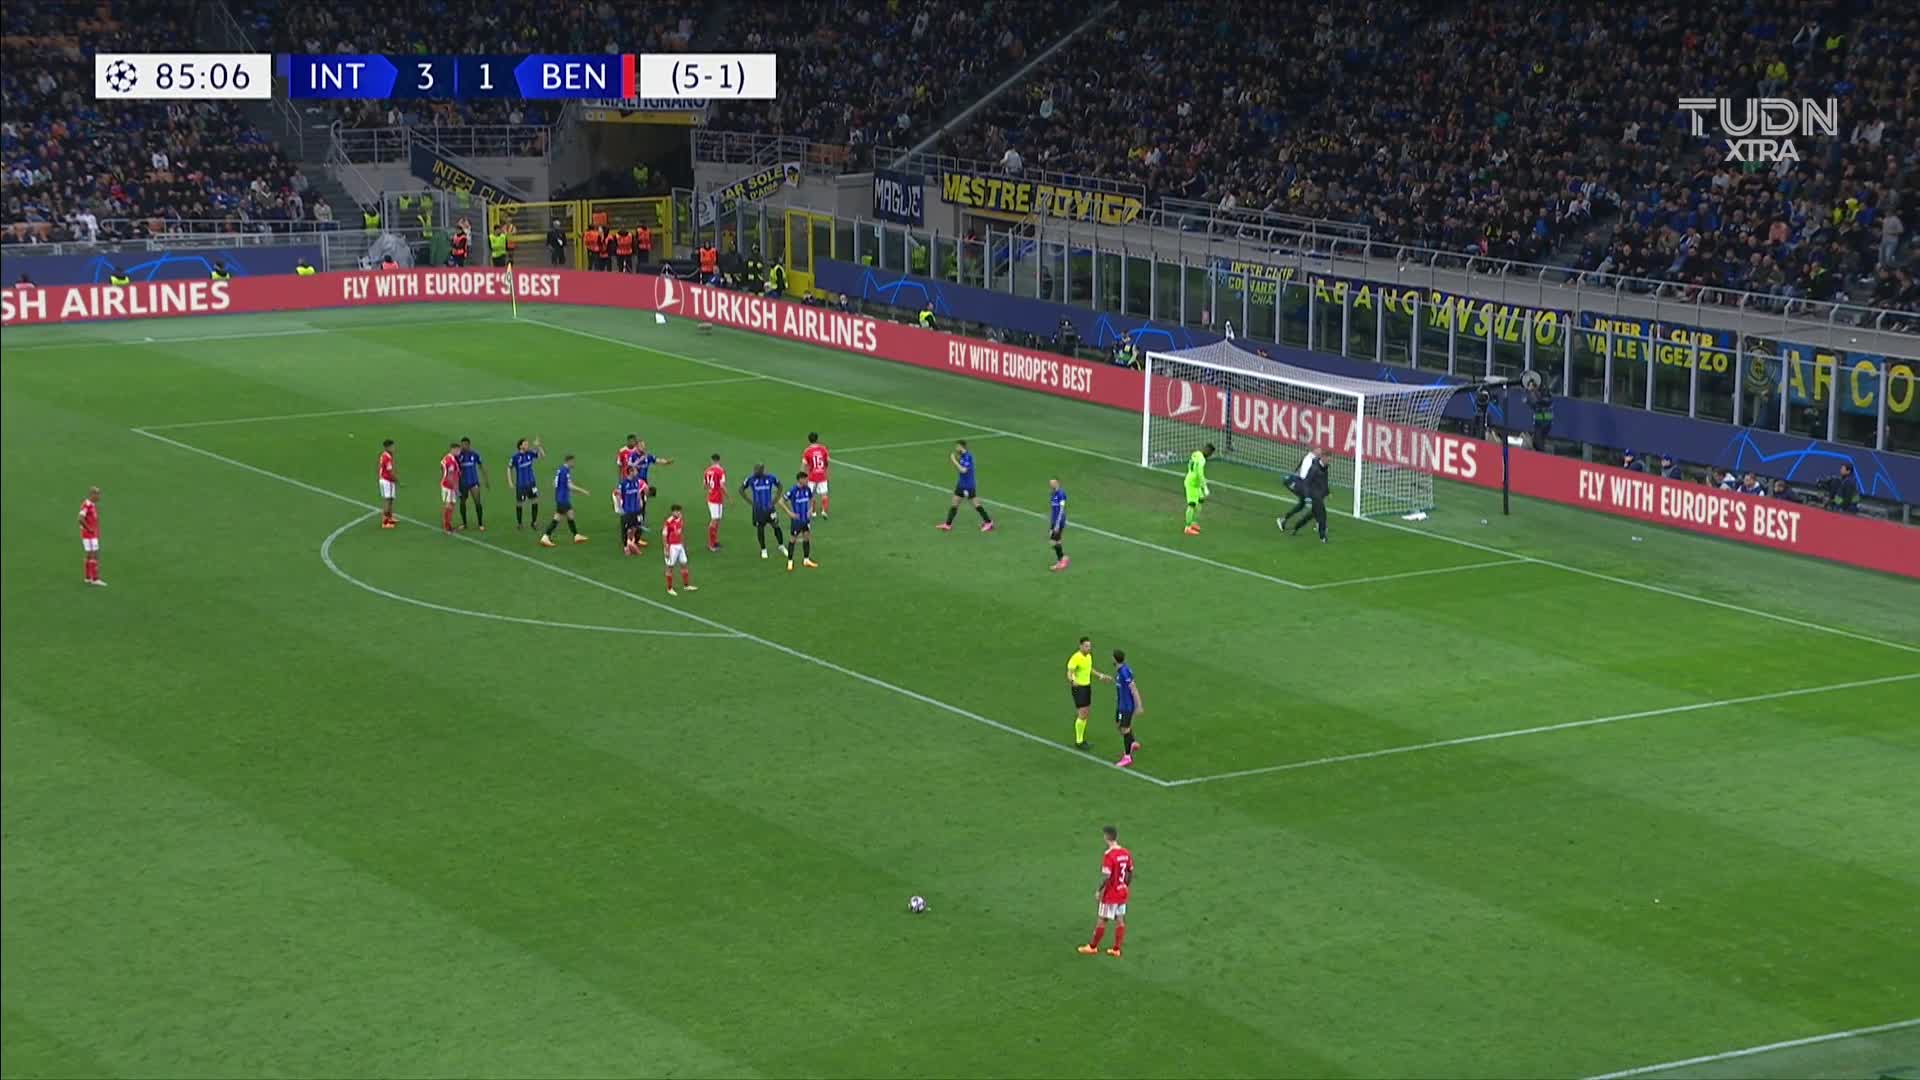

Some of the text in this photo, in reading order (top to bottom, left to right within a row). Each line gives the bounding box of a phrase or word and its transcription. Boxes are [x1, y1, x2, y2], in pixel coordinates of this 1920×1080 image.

[432, 160, 476, 192] INTER
[748, 168, 784, 190] SOLE
[943, 173, 1032, 213] MESTRE
[874, 177, 921, 217] MAGLIE
[60, 281, 231, 319] AIRLINES
[343, 272, 560, 300] FLY WITH EUROPE'S BEST
[690, 287, 878, 351] TURKISH AIRLINES
[1428, 292, 1475, 334] SAN
[1594, 318, 1641, 338] INTER
[1586, 333, 1637, 360] VALE
[949, 341, 1093, 393] FLY WITH EUROPE'S BEST
[1216, 390, 1477, 478] TURKISH AIRLINES
[1579, 469, 1801, 543] FLY WITH EUROPE'S BEST
[1118, 862, 1127, 882] 3
